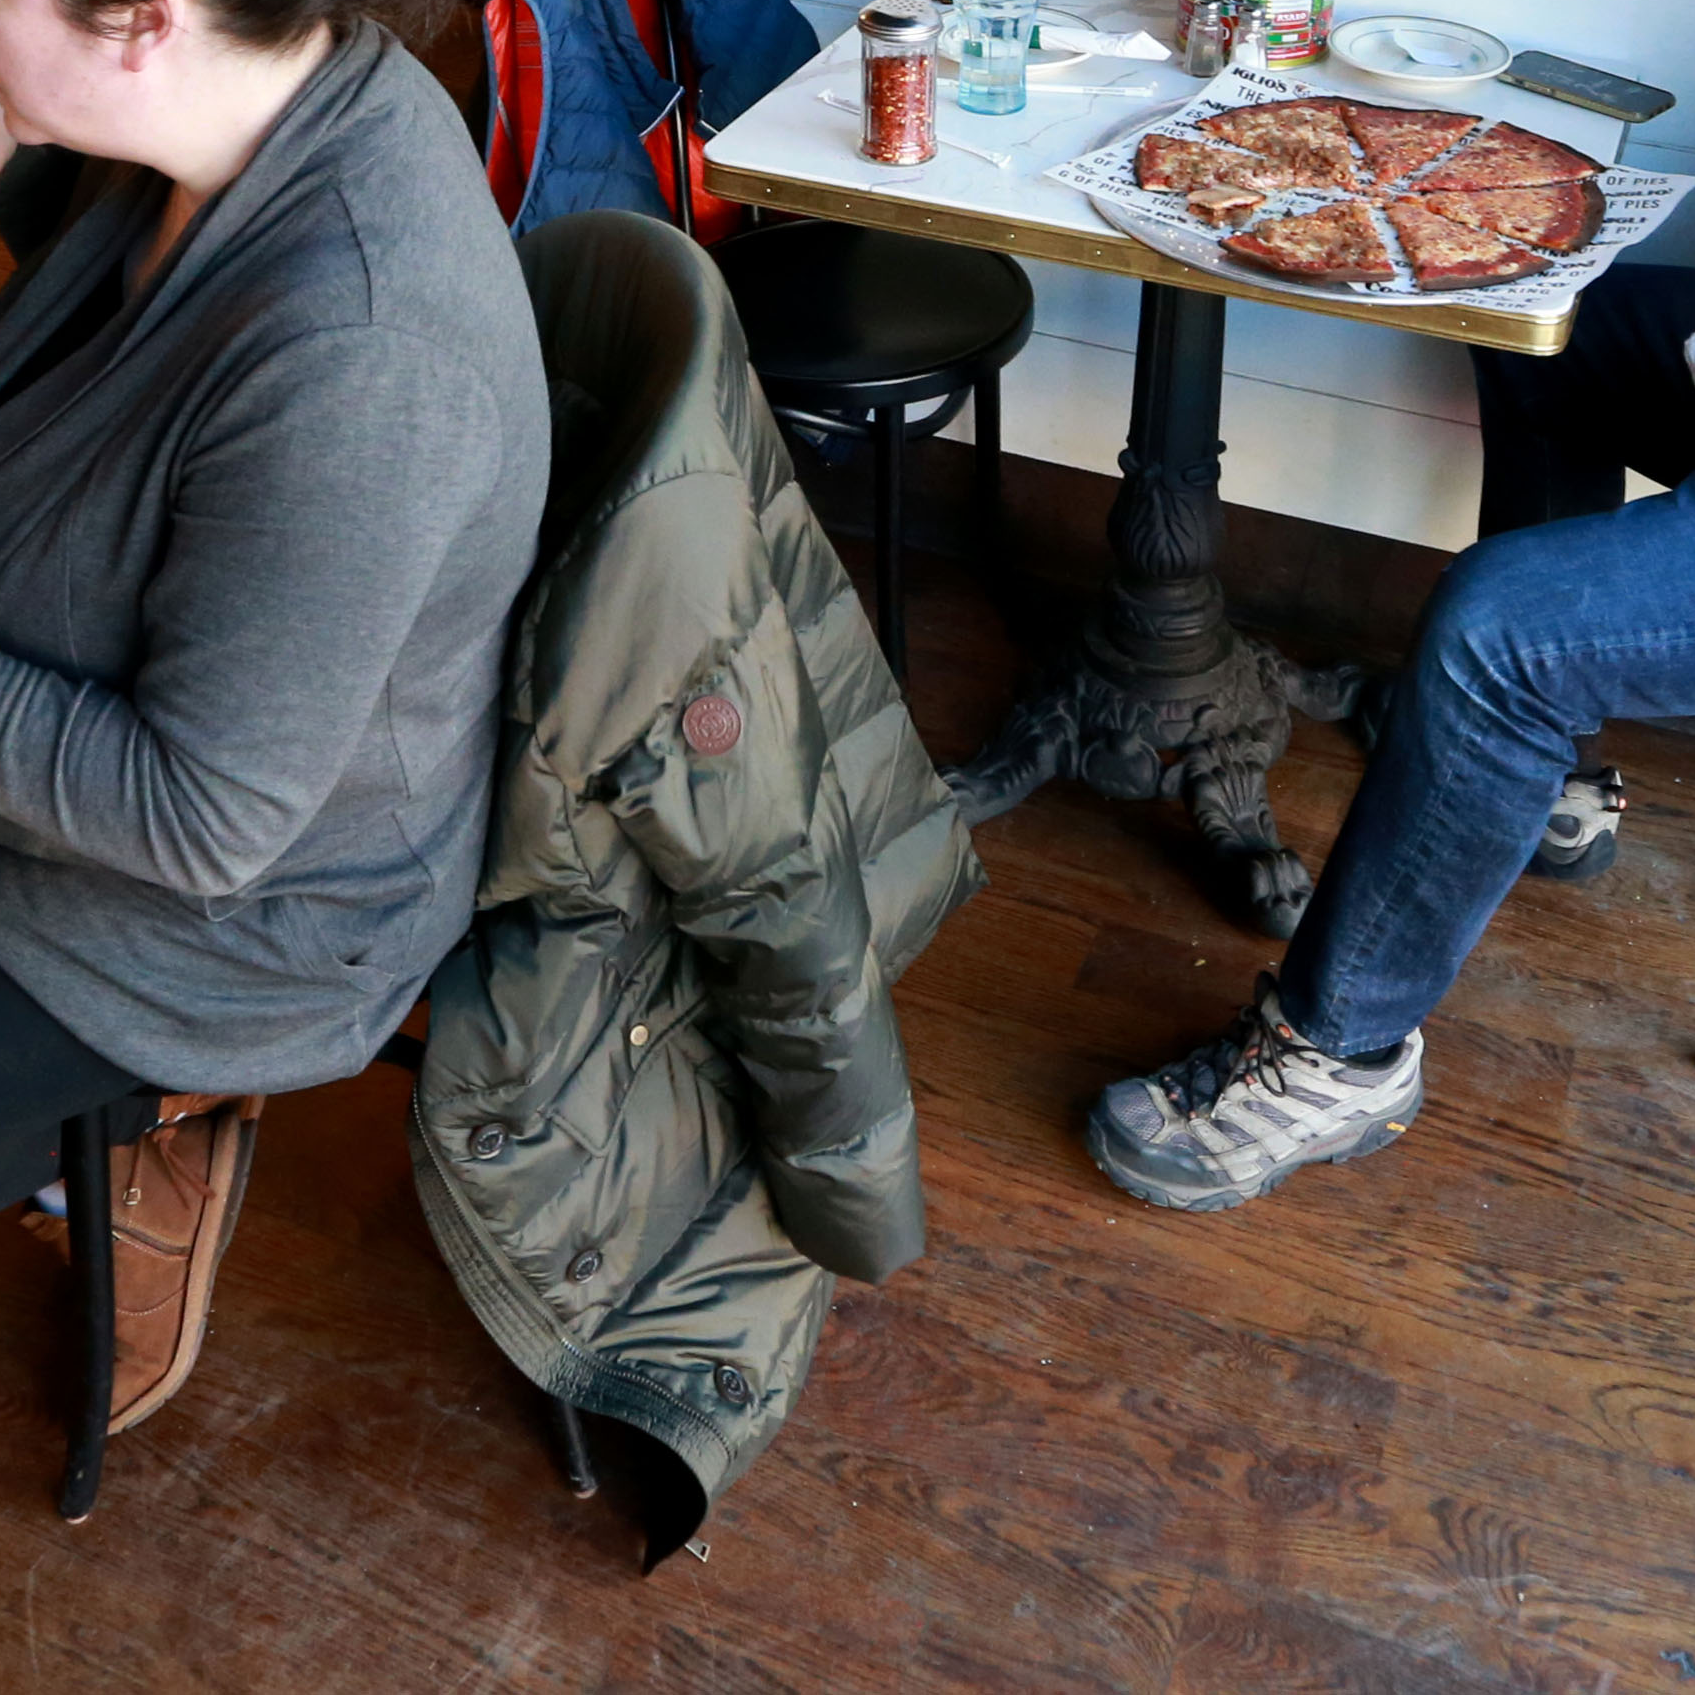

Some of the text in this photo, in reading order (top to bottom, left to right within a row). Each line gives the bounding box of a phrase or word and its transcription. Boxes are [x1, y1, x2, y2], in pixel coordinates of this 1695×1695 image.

[1606, 176, 1669, 186] OF PIES
[1074, 175, 1095, 187] OF
[1098, 181, 1133, 198] PIES
[1624, 200, 1661, 209] PIES
